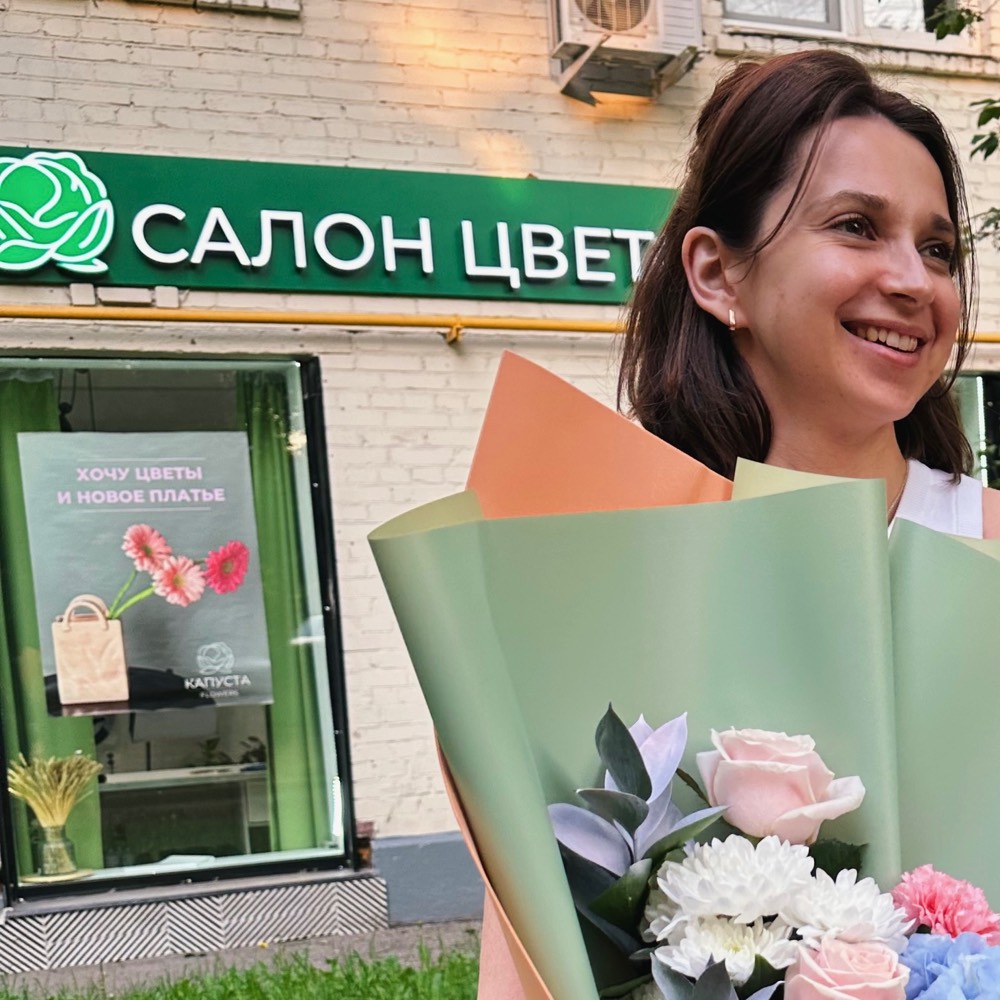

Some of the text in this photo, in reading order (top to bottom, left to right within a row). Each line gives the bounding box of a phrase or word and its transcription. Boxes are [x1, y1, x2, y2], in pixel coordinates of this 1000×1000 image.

[131, 203, 656, 289] САЛОН ЦВЕТ
[76, 466, 203, 482] ХОЧУ ЦВЕТЫ
[57, 488, 226, 504] И НОВОЕ ПЛАТЬЕ
[184, 675, 252, 690] КАПУСТА
